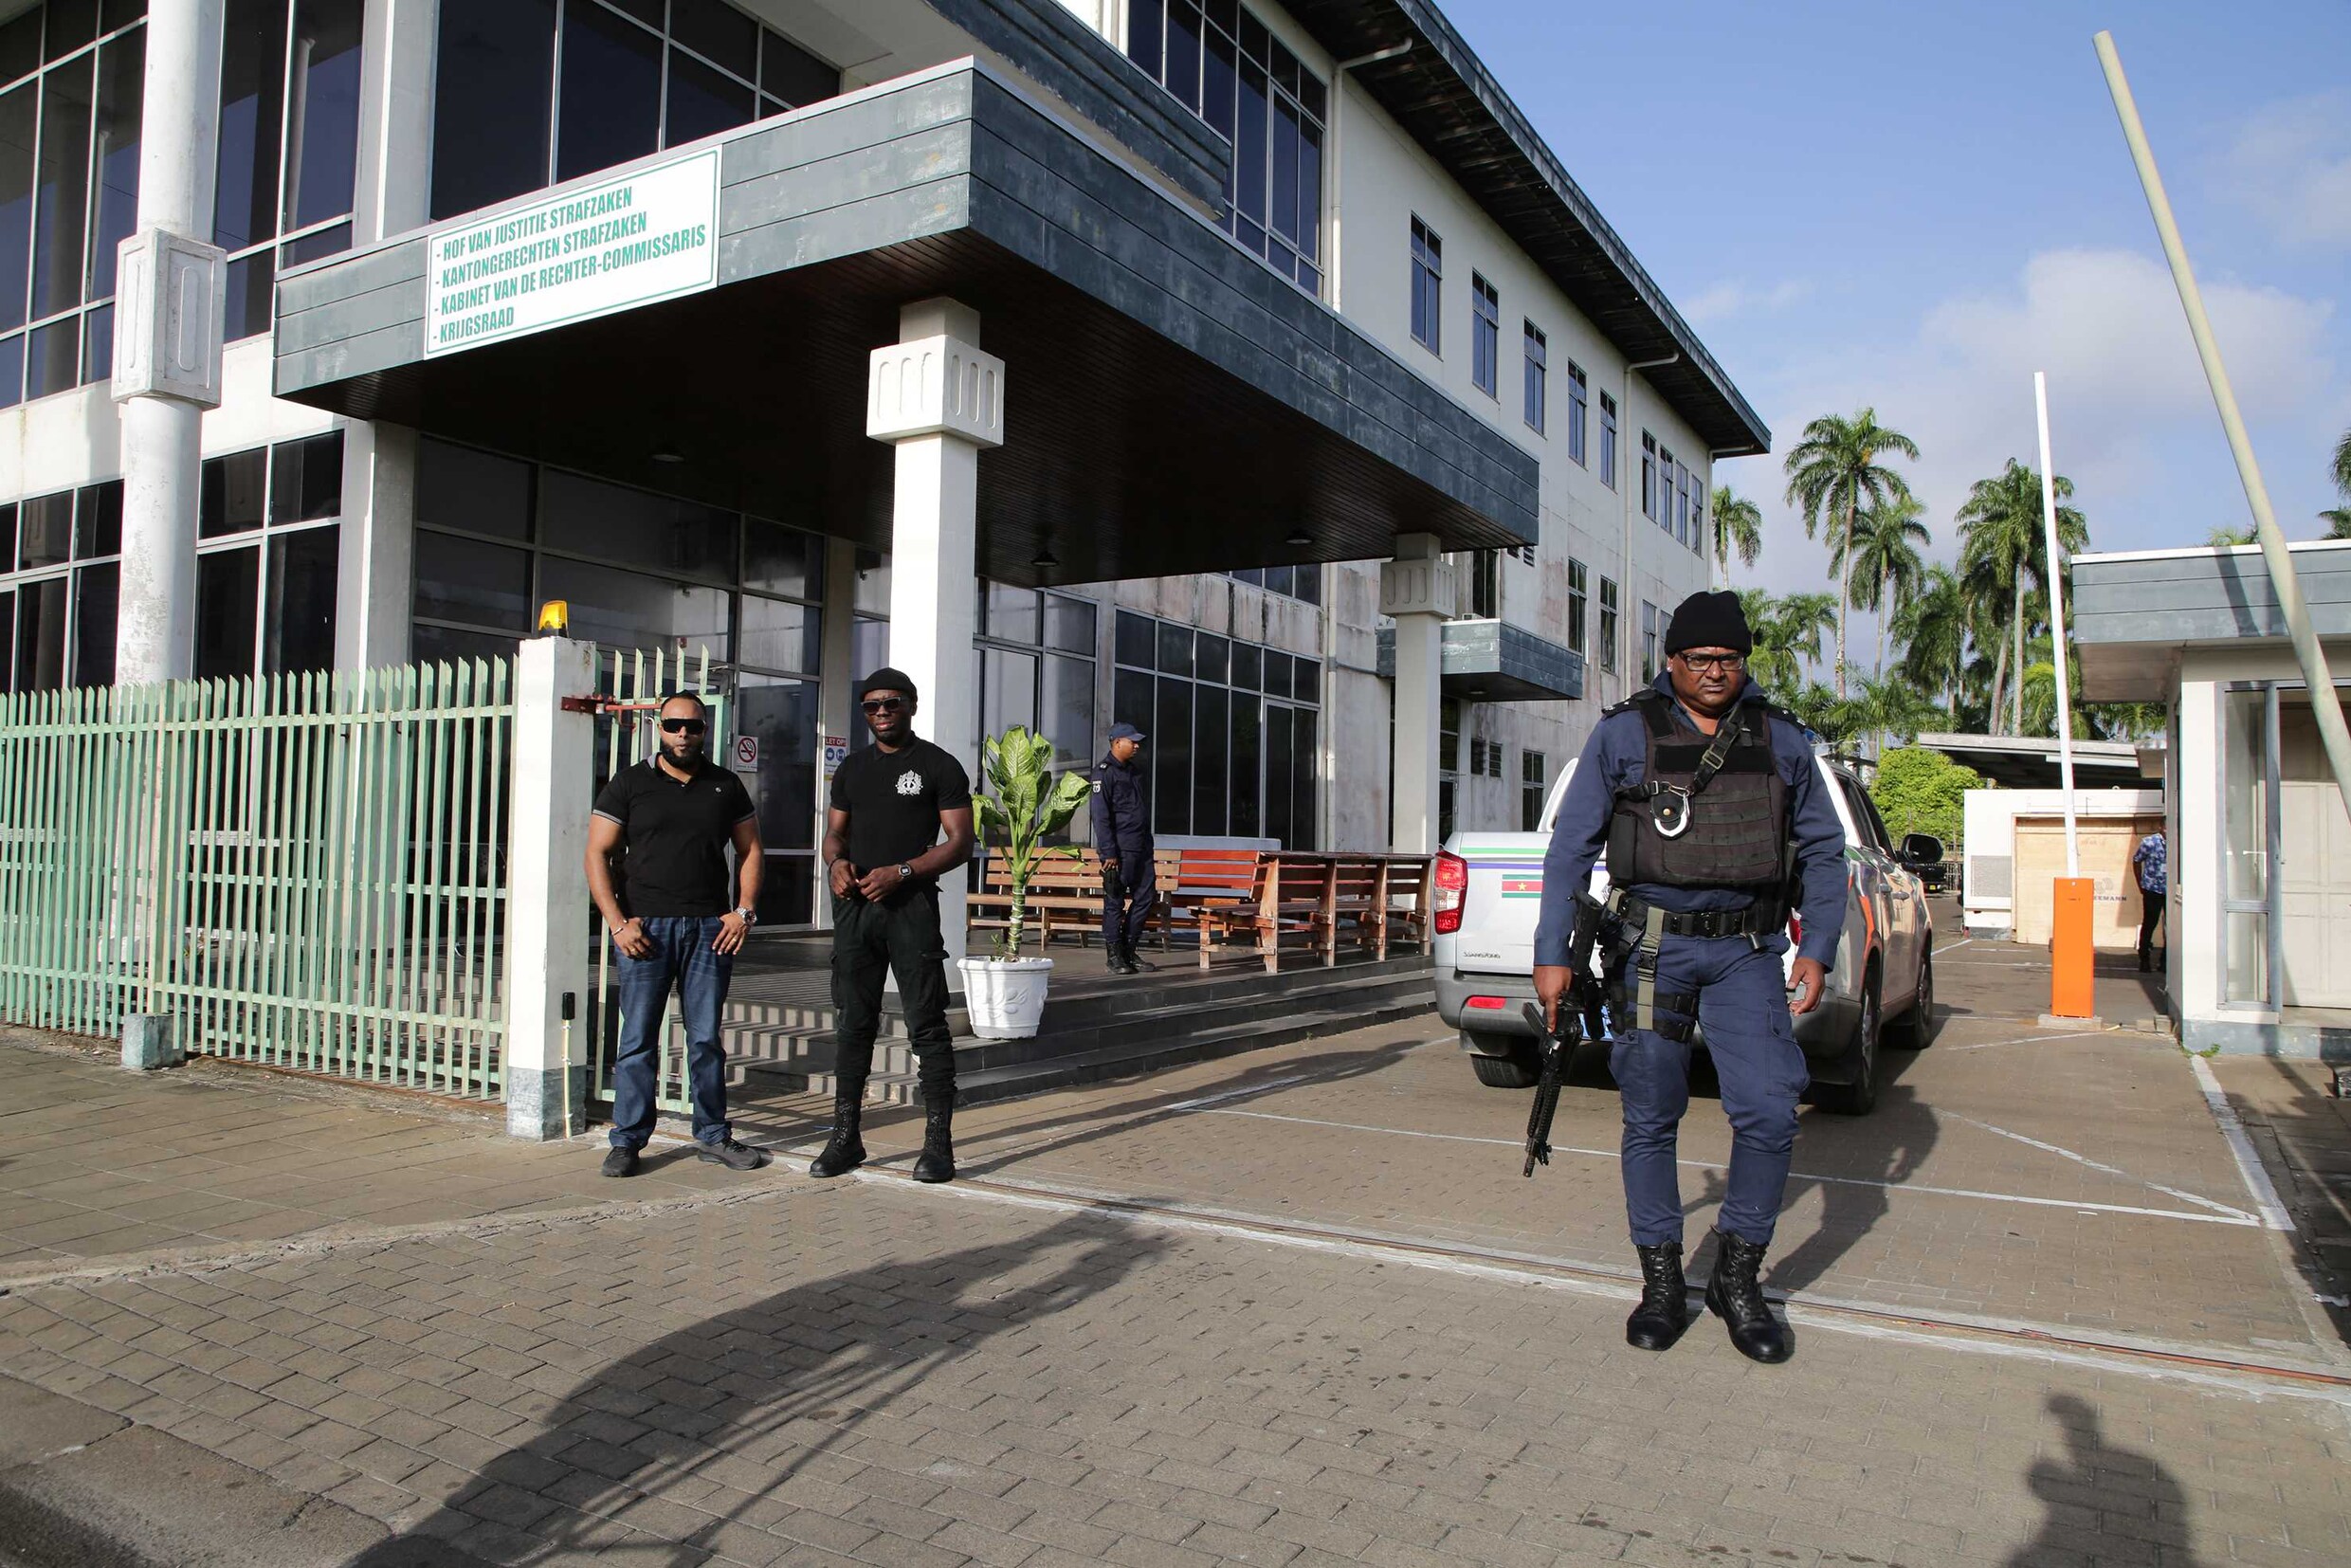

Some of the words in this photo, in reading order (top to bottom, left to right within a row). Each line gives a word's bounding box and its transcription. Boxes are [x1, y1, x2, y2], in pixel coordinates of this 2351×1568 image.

[442, 236, 560, 289] KANTONGERECHTEN
[563, 210, 647, 254] STRAFZAKEN
[443, 236, 466, 262] HOF
[468, 228, 492, 254] VAN
[494, 211, 547, 246] JUSTITIE
[550, 186, 632, 229] STRAFZAKEN
[441, 283, 491, 316] KABINET
[493, 277, 518, 301] VAN
[520, 271, 537, 295] DE
[538, 224, 706, 289] RECHTER-COMMISSARIS
[440, 306, 515, 343] KRIJGSRAAD
